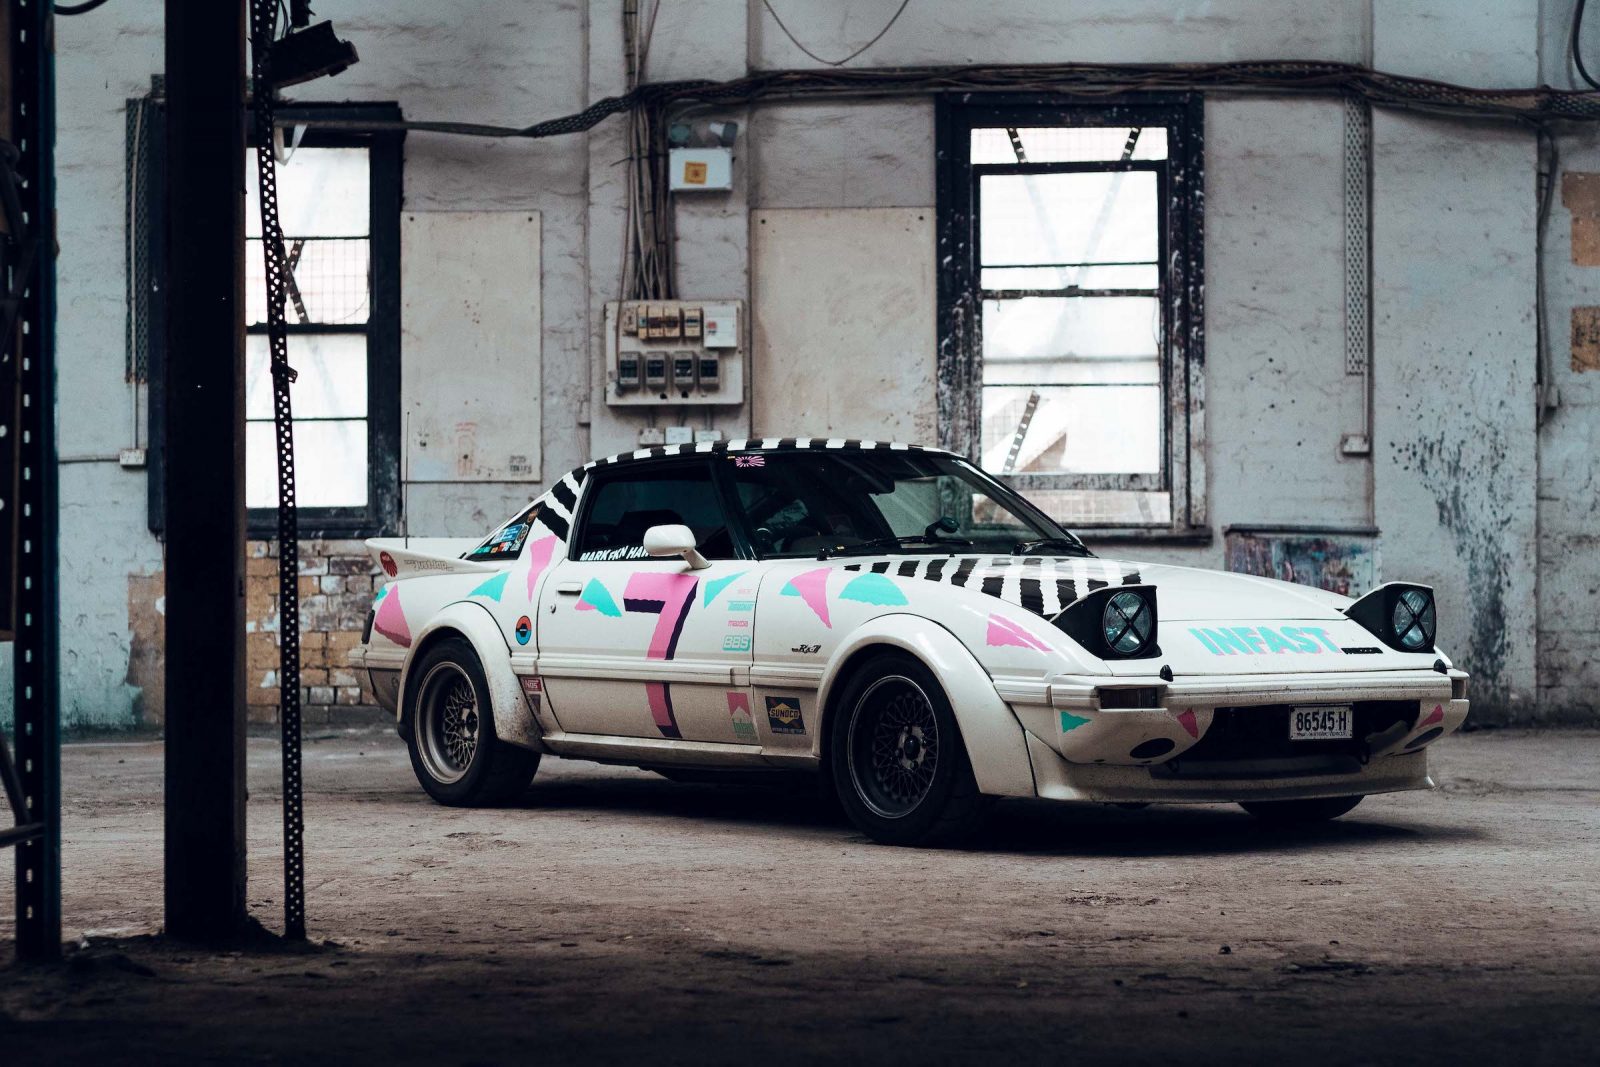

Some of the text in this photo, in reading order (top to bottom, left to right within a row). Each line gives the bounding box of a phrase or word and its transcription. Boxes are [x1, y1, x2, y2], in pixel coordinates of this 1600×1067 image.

[723, 634, 750, 652] BBS
[1187, 626, 1343, 656] INFAST
[623, 572, 700, 738] 7
[770, 708, 799, 718] SUNOCO
